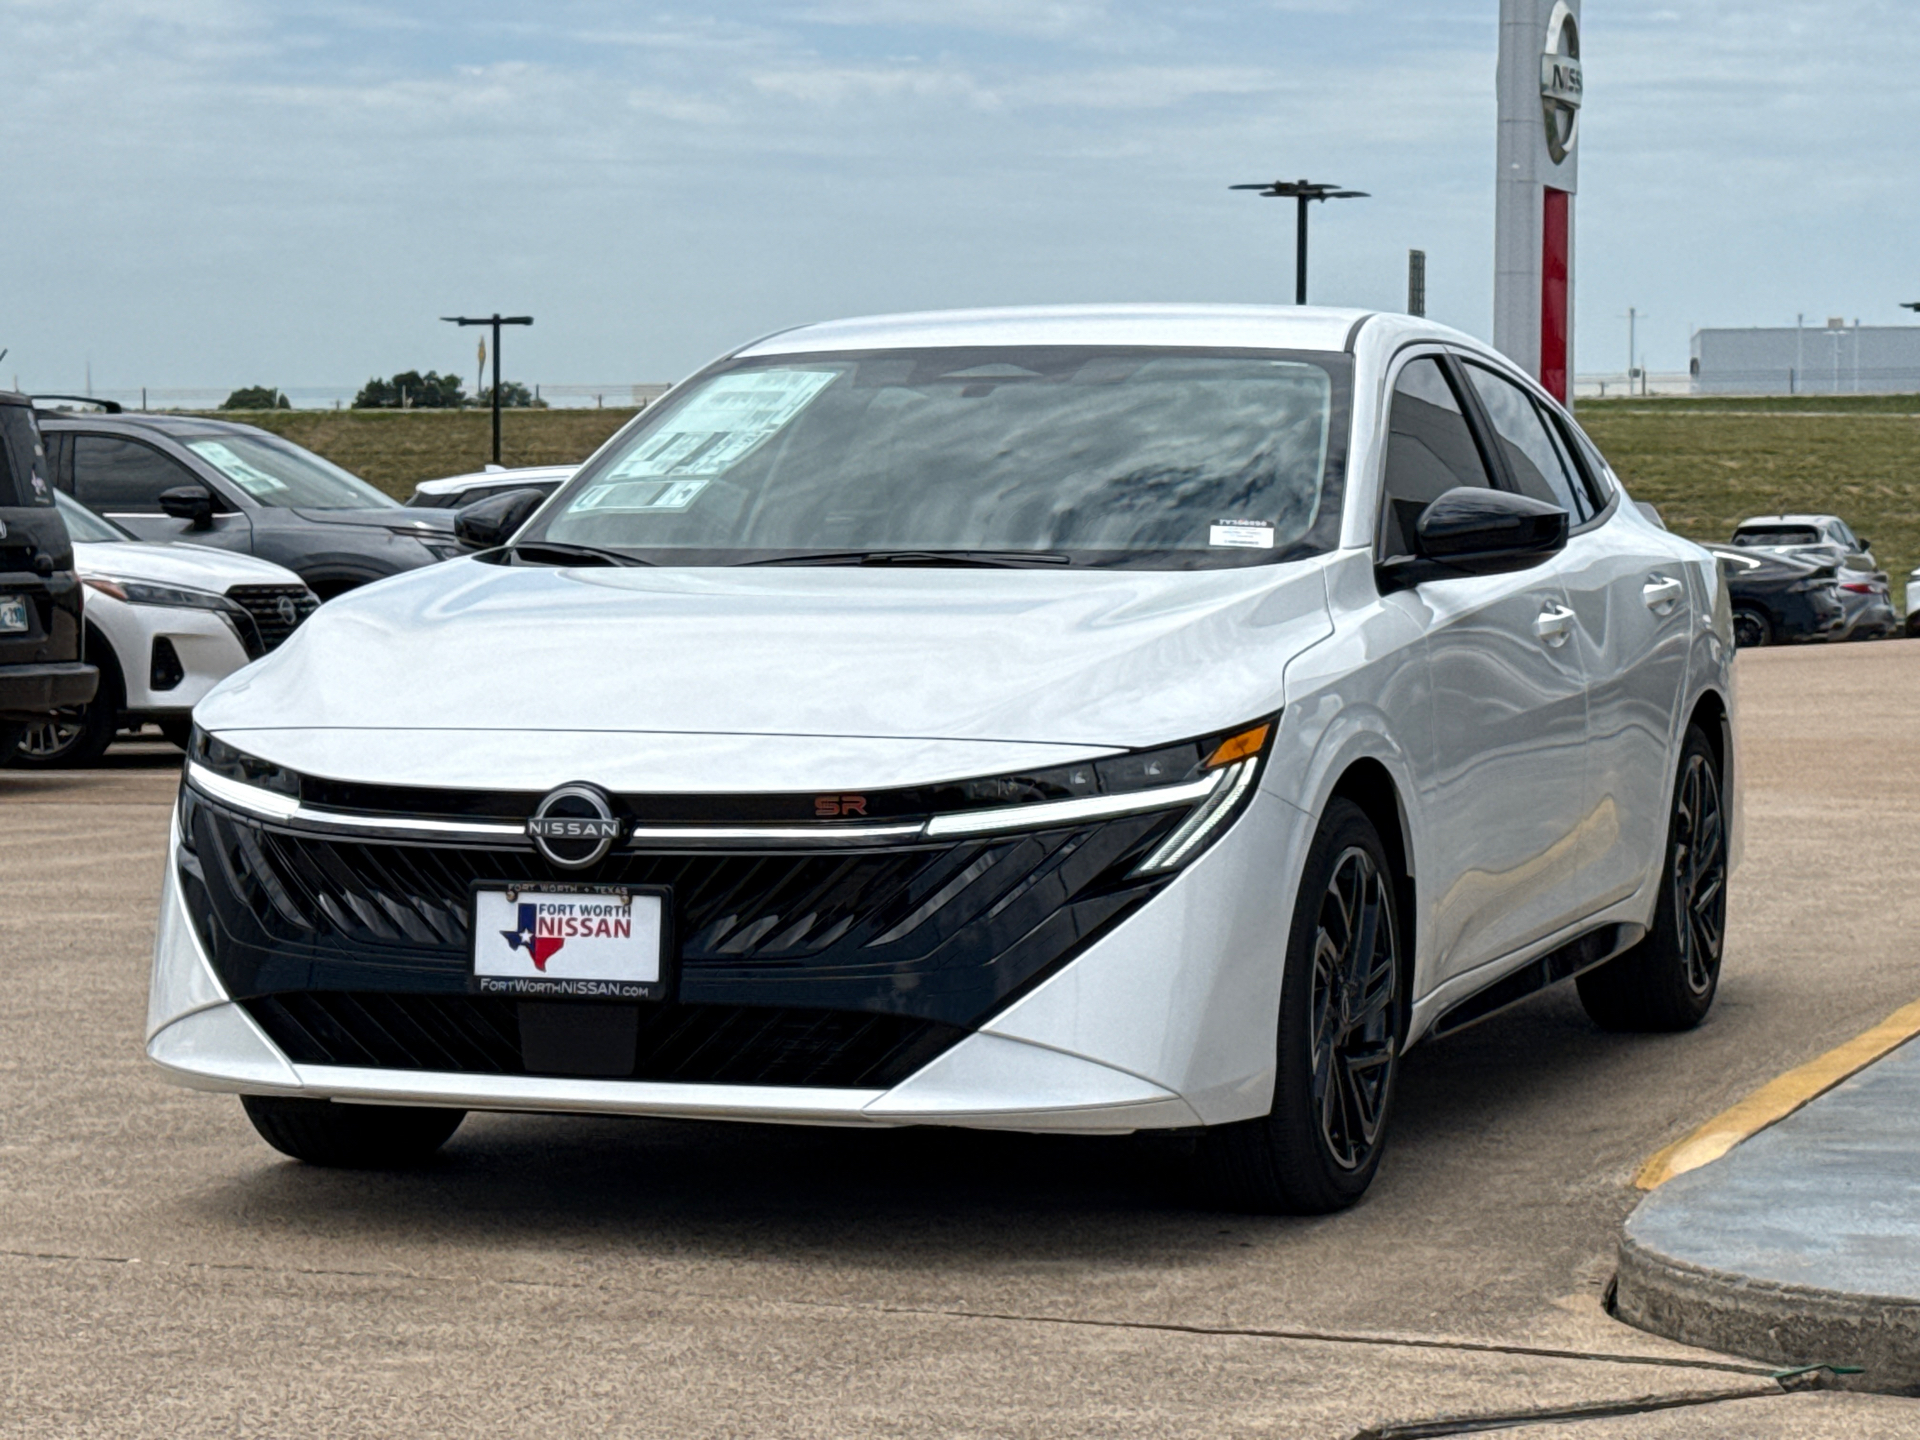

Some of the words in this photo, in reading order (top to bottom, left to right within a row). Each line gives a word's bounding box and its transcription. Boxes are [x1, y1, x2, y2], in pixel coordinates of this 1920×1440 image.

[815, 796, 868, 816] SR
[529, 821, 617, 836] NISSAN
[508, 883, 536, 892] FORT
[539, 884, 578, 893] WORTH
[594, 885, 628, 895] TEXAS
[539, 903, 576, 917] FORT
[579, 904, 631, 917] WORTH
[538, 917, 631, 938] NISSAN
